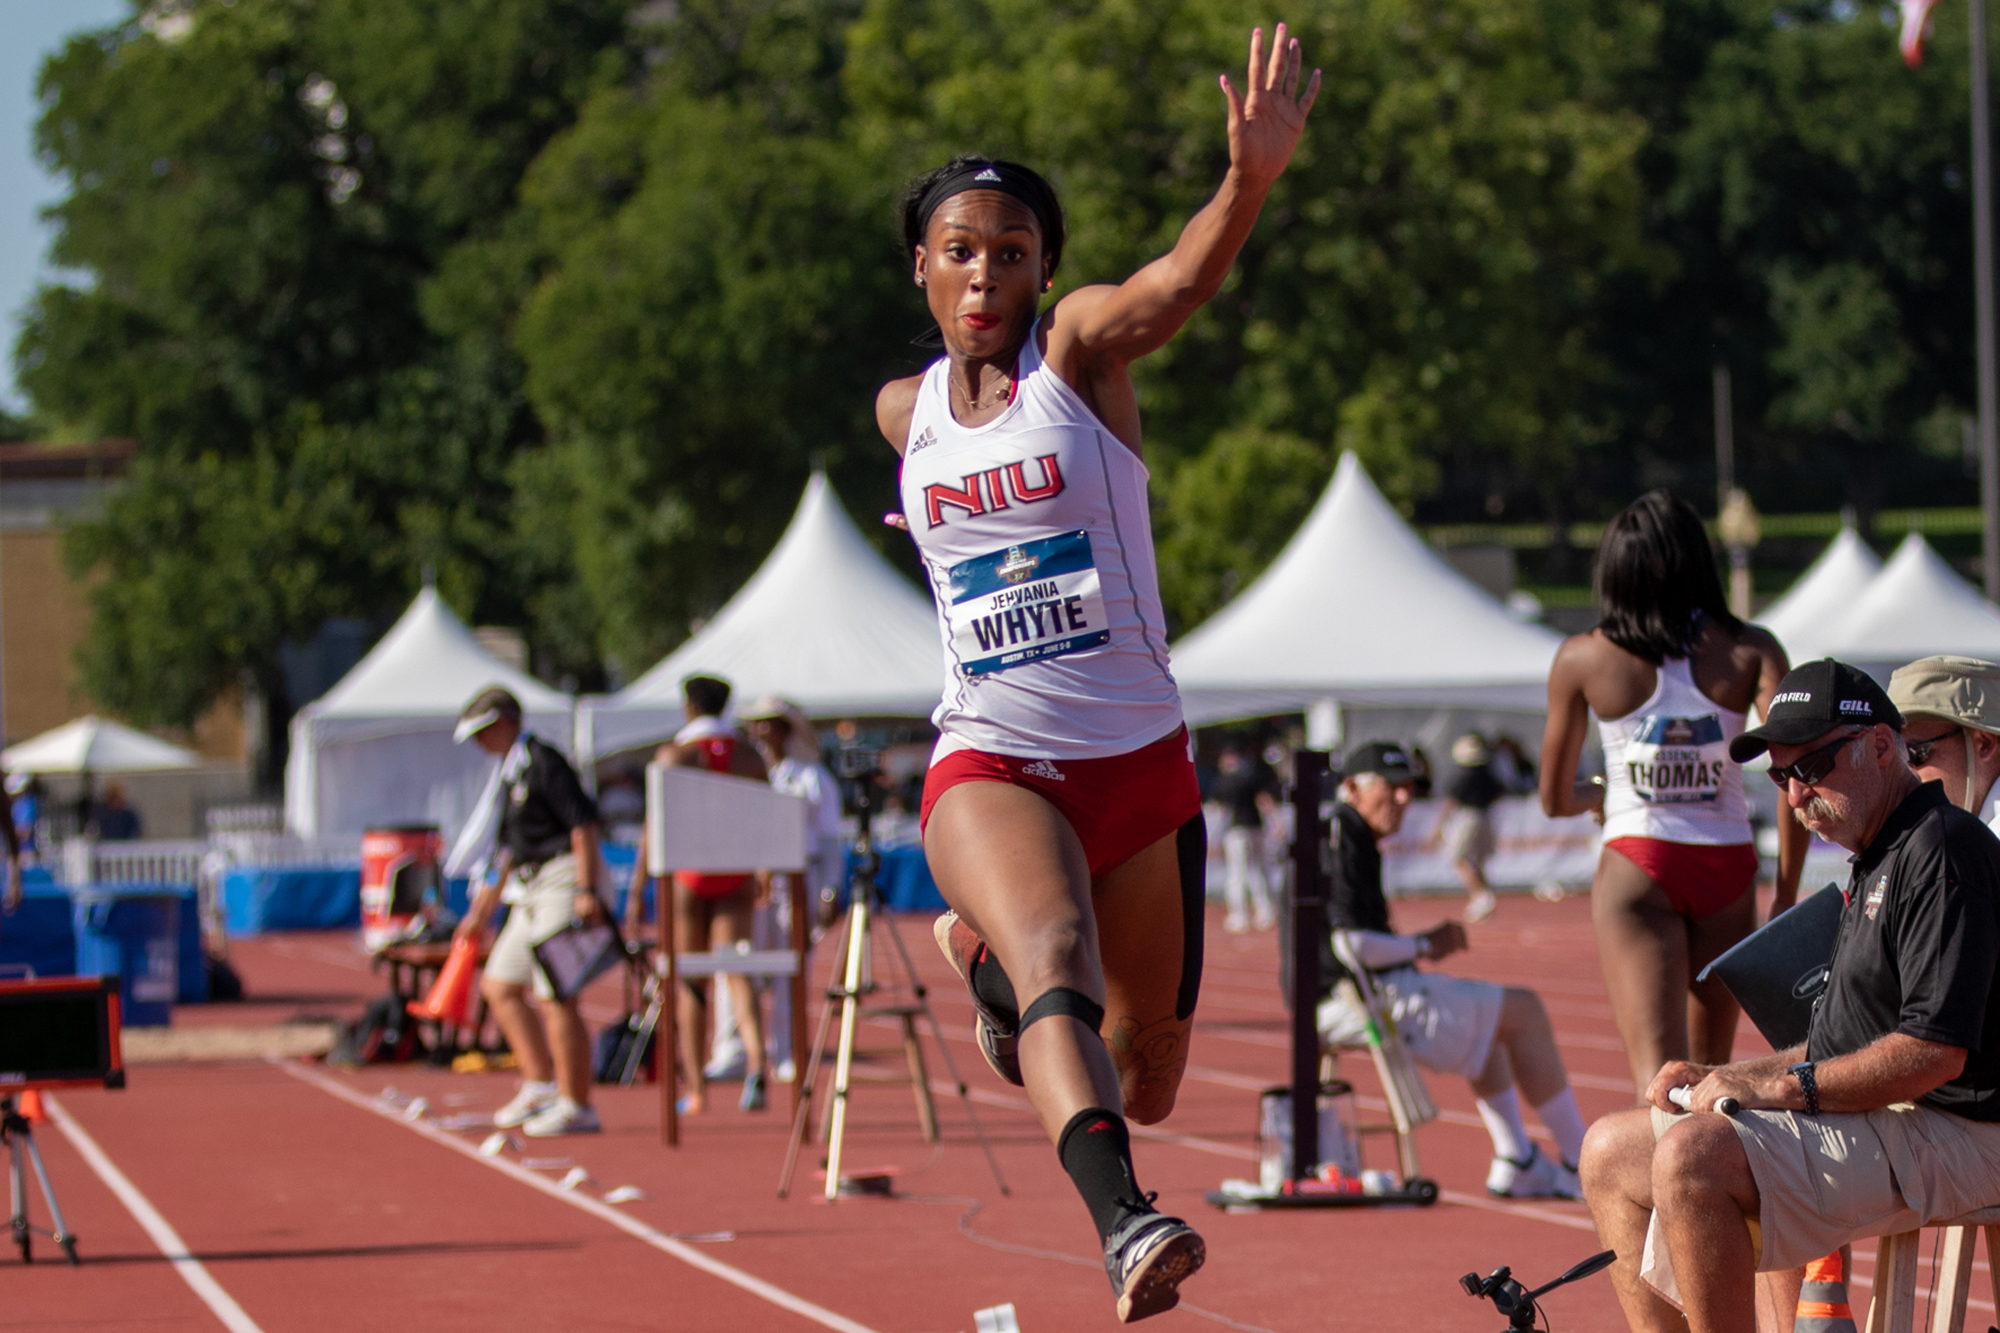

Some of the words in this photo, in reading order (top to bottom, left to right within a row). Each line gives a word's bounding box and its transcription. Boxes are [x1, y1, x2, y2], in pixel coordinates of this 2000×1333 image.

[922, 451, 1067, 531] NIU
[990, 581, 1059, 612] JEHVANIA
[971, 595, 1088, 653] WHYTE
[1026, 649, 1036, 659] TX
[1042, 644, 1059, 655] JUNE
[1787, 691, 1812, 703] FIELD
[1839, 699, 1872, 712] GILL
[1022, 766, 1066, 781] adidas
[1628, 760, 1724, 789] THOMAS
